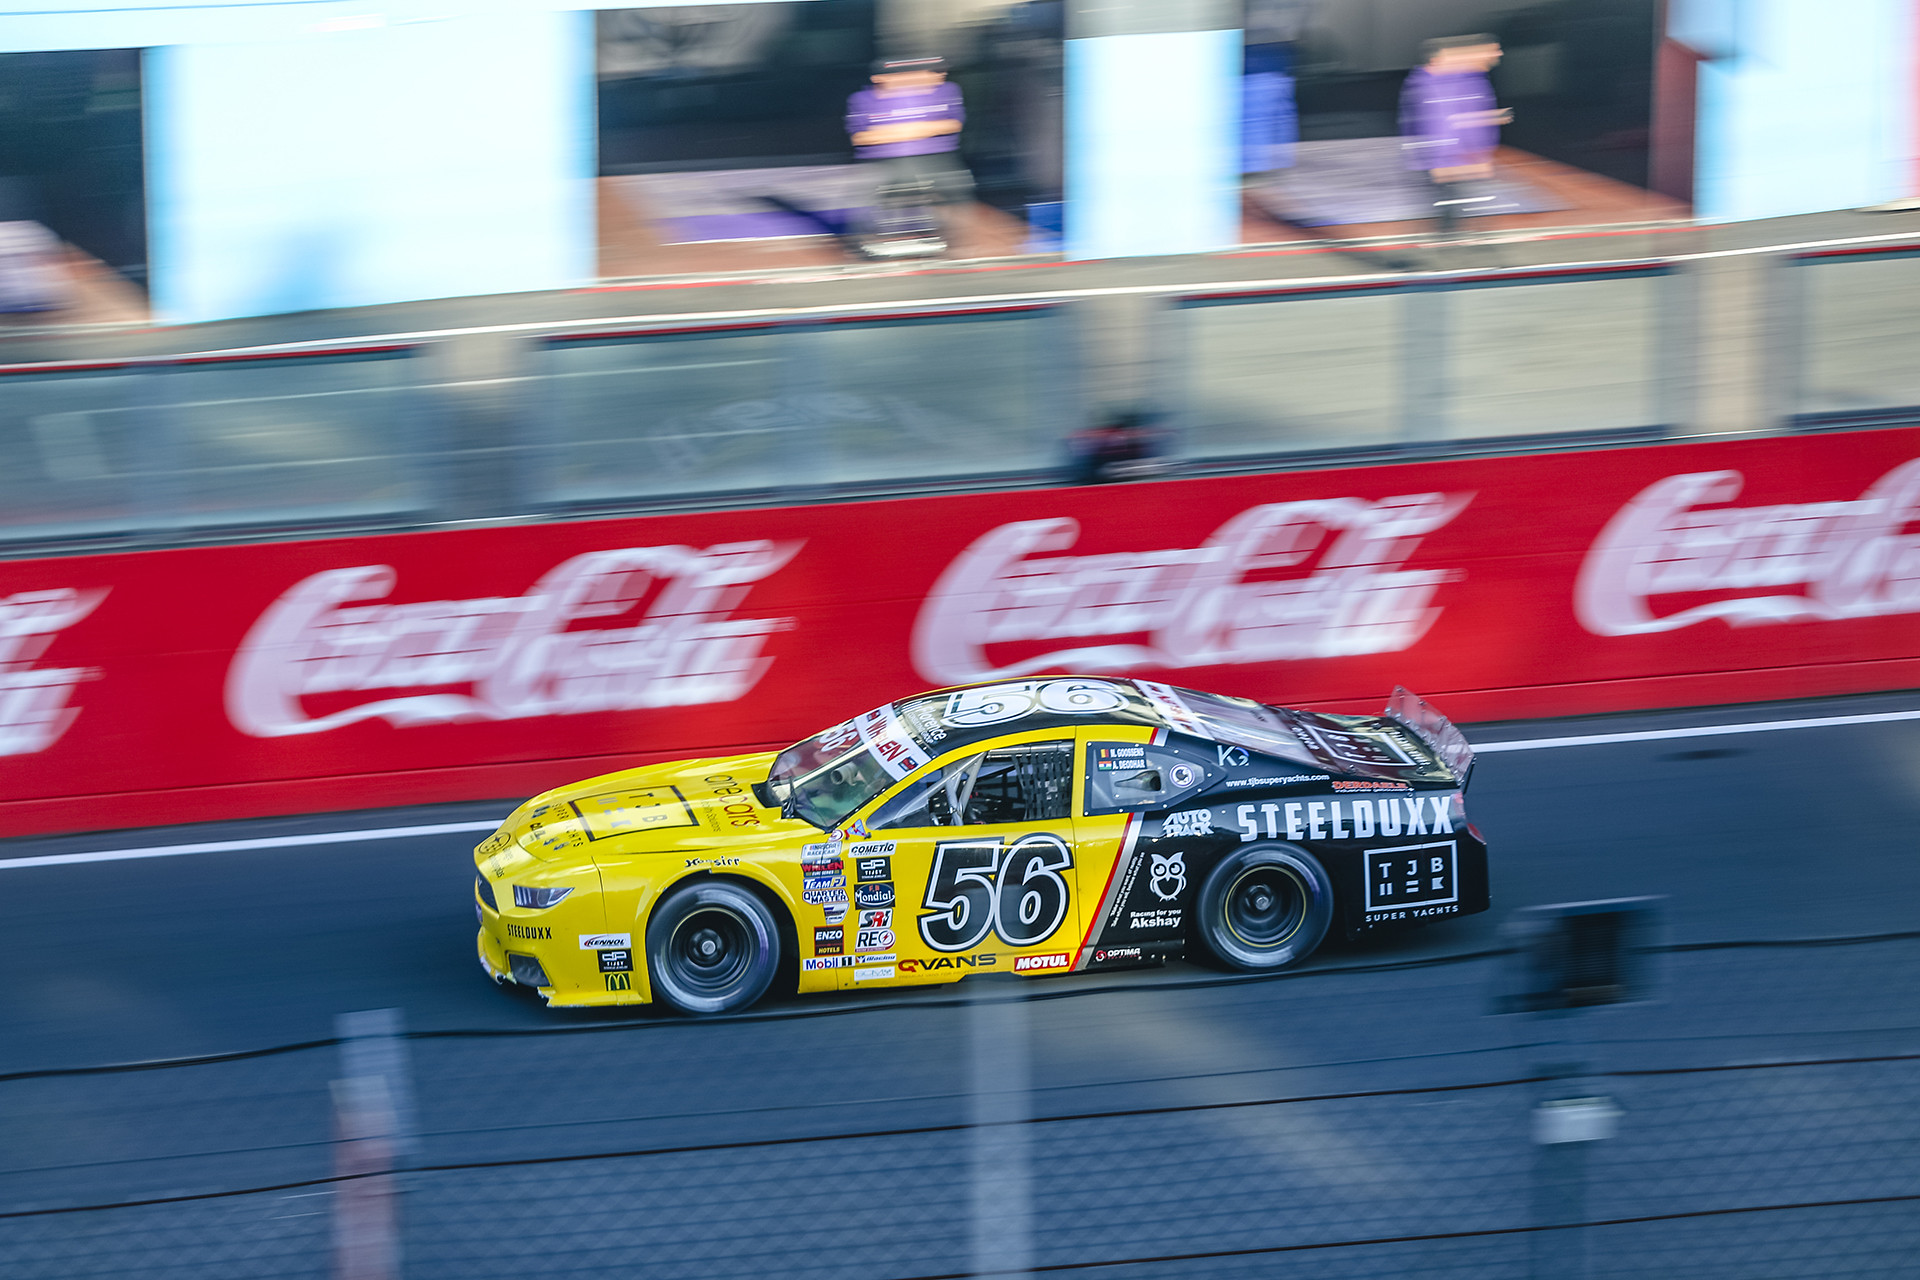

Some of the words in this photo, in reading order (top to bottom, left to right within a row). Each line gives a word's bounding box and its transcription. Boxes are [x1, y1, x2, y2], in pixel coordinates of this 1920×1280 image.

[940, 678, 1131, 729] 56
[1117, 747, 1145, 758] GOOSSENS
[1225, 775, 1330, 788] www.tjbsuperyachts.com
[1162, 809, 1212, 827] AUTO
[1237, 796, 1455, 842] STEELDUXX
[1163, 822, 1215, 838] TRACK
[851, 842, 895, 855] COMETIC
[855, 889, 893, 903] Mondial
[917, 832, 1074, 953] 56
[1130, 911, 1155, 919] Racing
[1168, 908, 1182, 917] you
[1365, 911, 1406, 922] SUPER
[1413, 904, 1459, 918] YACHTS
[1130, 916, 1182, 929] Akshay
[507, 924, 552, 940] STEELDUXX
[815, 930, 843, 941] ENZO
[587, 939, 626, 947] KENNOL
[1107, 947, 1141, 957] OPTIMA
[805, 957, 838, 970] Mobil
[1016, 955, 1068, 970] MOTUL
